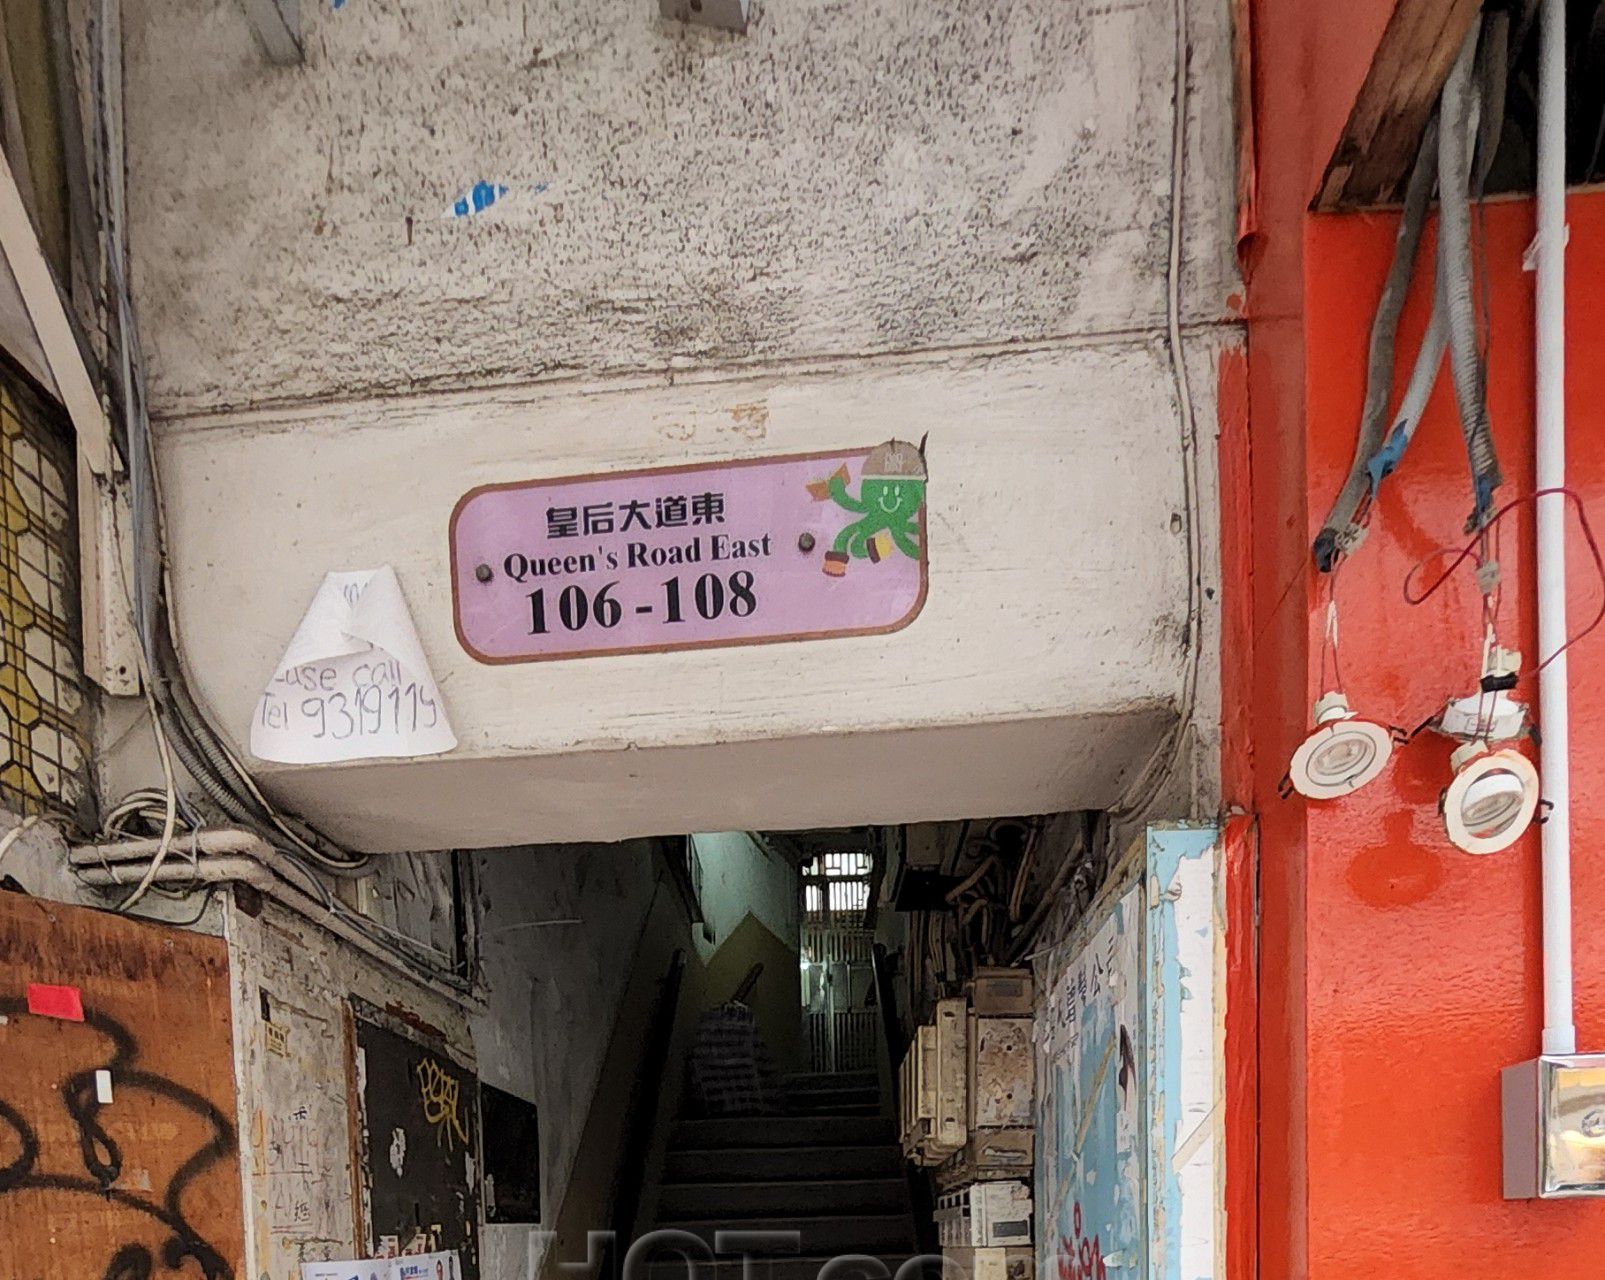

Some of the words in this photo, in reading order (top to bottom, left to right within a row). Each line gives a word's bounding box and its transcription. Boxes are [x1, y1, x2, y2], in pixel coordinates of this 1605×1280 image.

[546, 492, 725, 539] 皇后大道東
[504, 545, 618, 583] Queen's
[627, 537, 701, 568] Road
[711, 533, 772, 561] East
[352, 660, 402, 688] call
[261, 692, 289, 731] Tel
